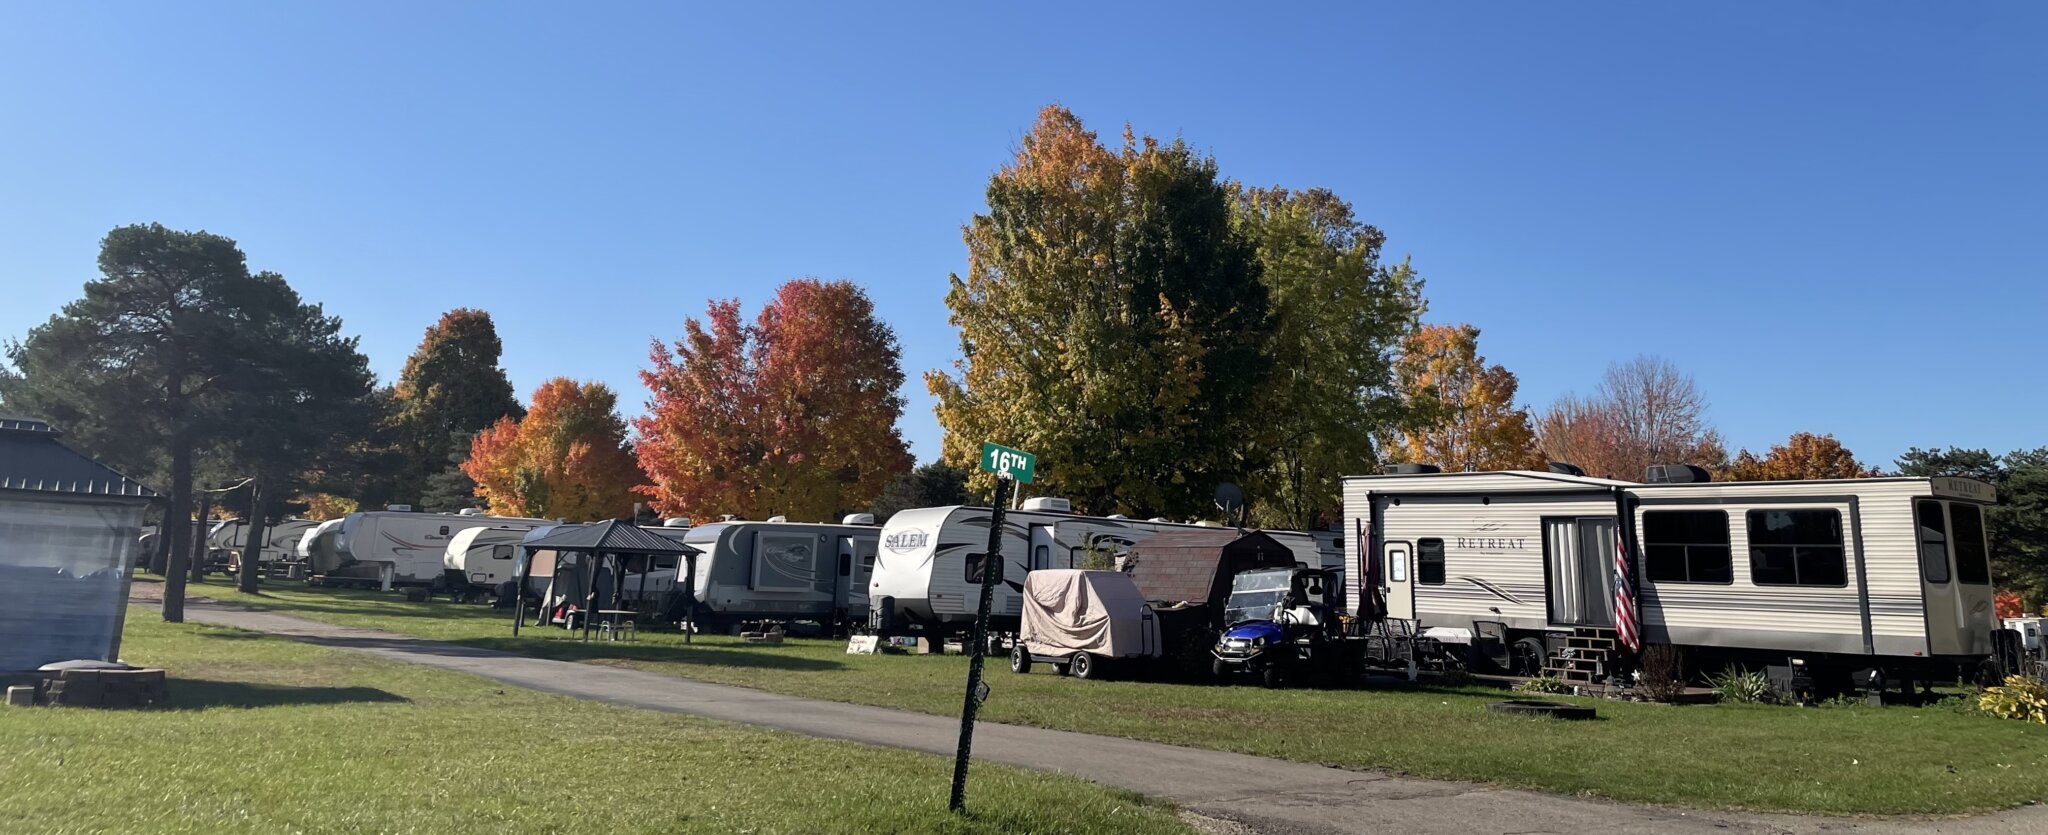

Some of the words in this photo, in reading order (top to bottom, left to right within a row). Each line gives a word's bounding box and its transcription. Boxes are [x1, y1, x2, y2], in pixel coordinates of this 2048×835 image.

[990, 448, 1027, 472] 16TH
[884, 533, 930, 548] SALEM
[1457, 537, 1525, 549] RETREAT
